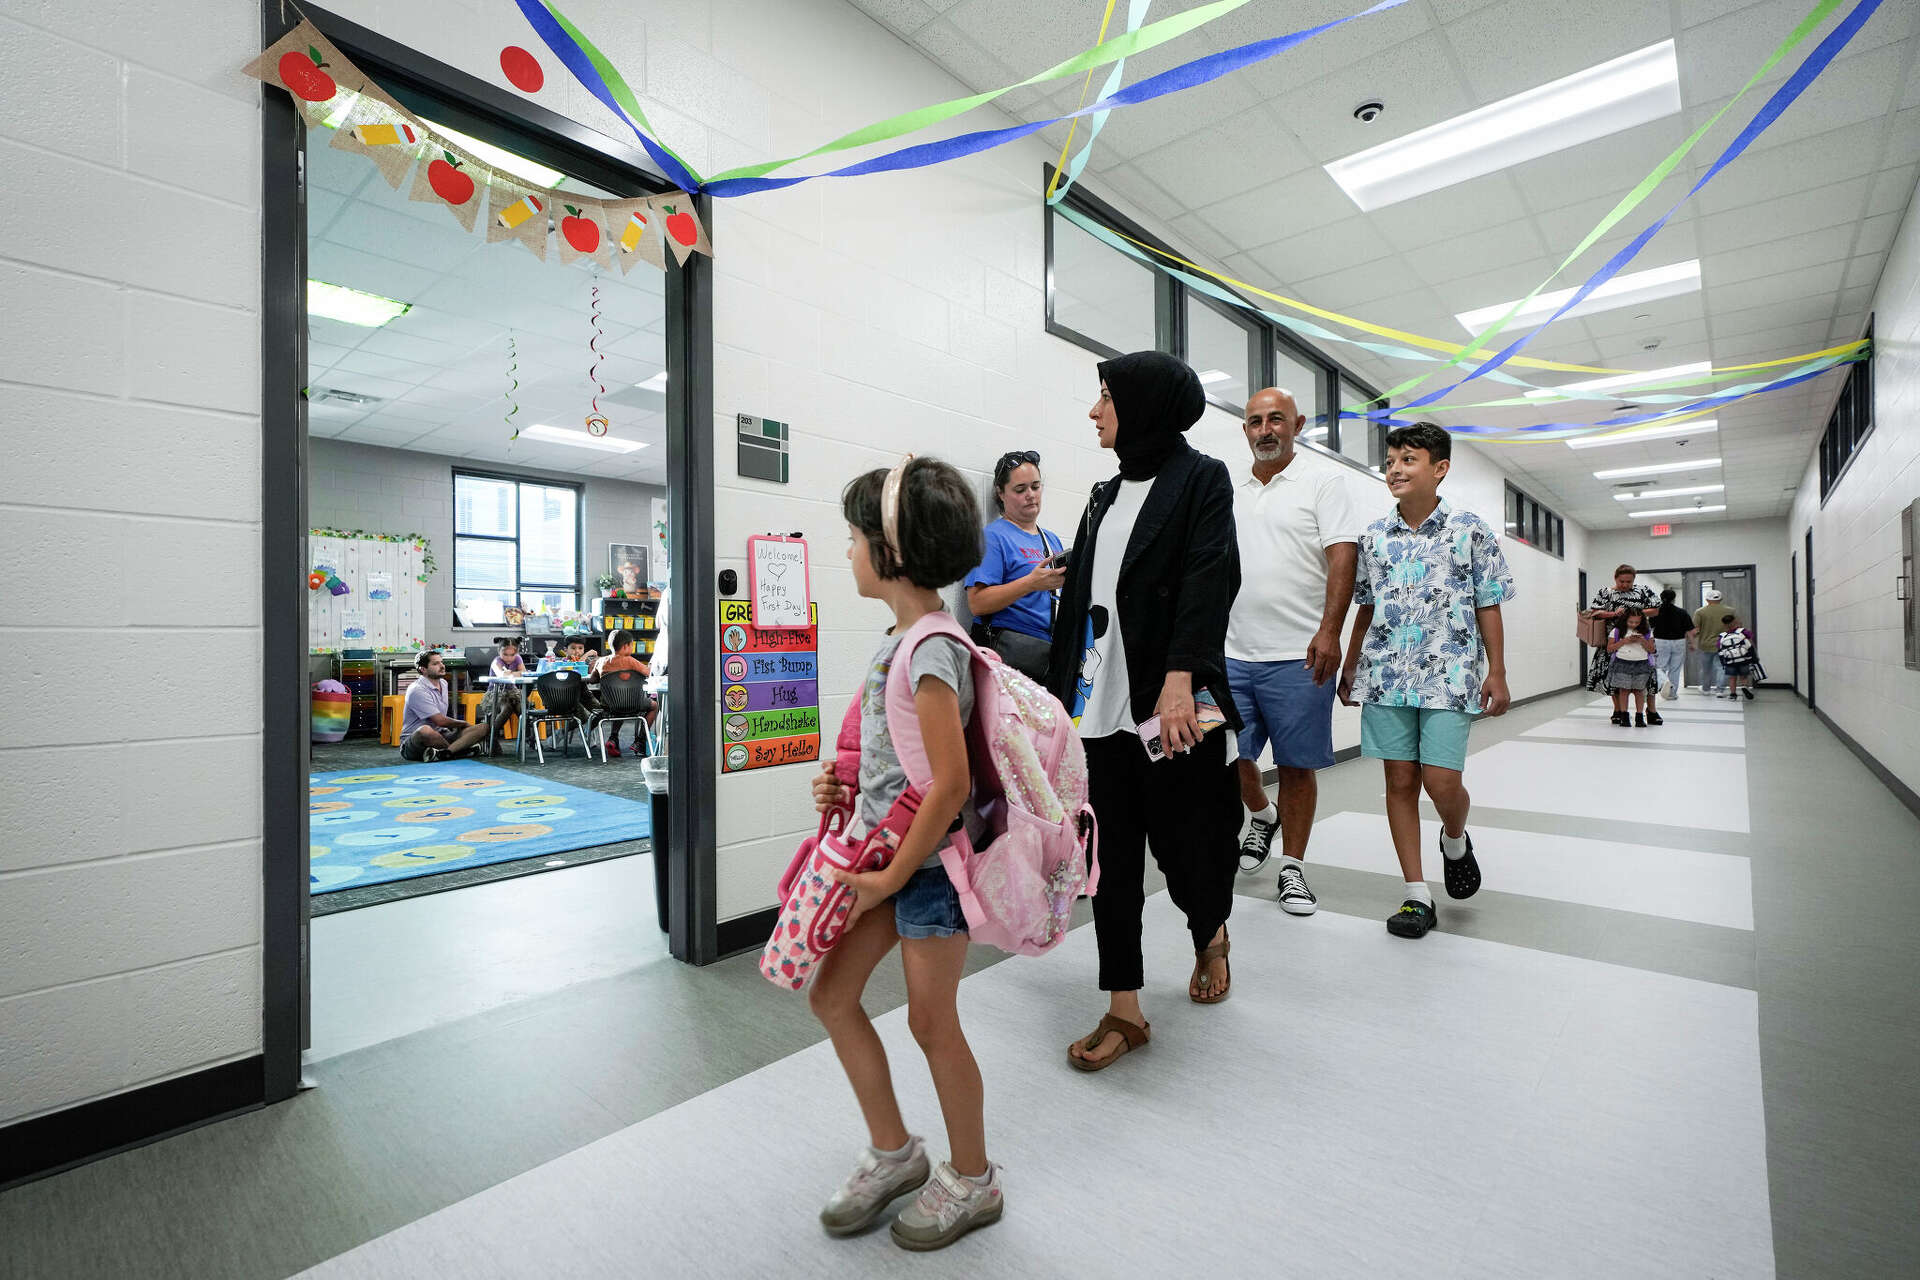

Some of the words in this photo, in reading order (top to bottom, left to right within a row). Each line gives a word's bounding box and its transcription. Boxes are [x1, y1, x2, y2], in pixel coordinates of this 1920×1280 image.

[741, 417, 752, 425] 203
[758, 544, 803, 565] Welcome!
[761, 577, 787, 597] Happy
[761, 595, 780, 611] First
[753, 659, 775, 674] Fist
[779, 657, 813, 675] Bump
[771, 685, 800, 705] Hug
[752, 711, 817, 736] Handshake
[755, 746, 776, 763] Say
[780, 740, 813, 762] Hello
